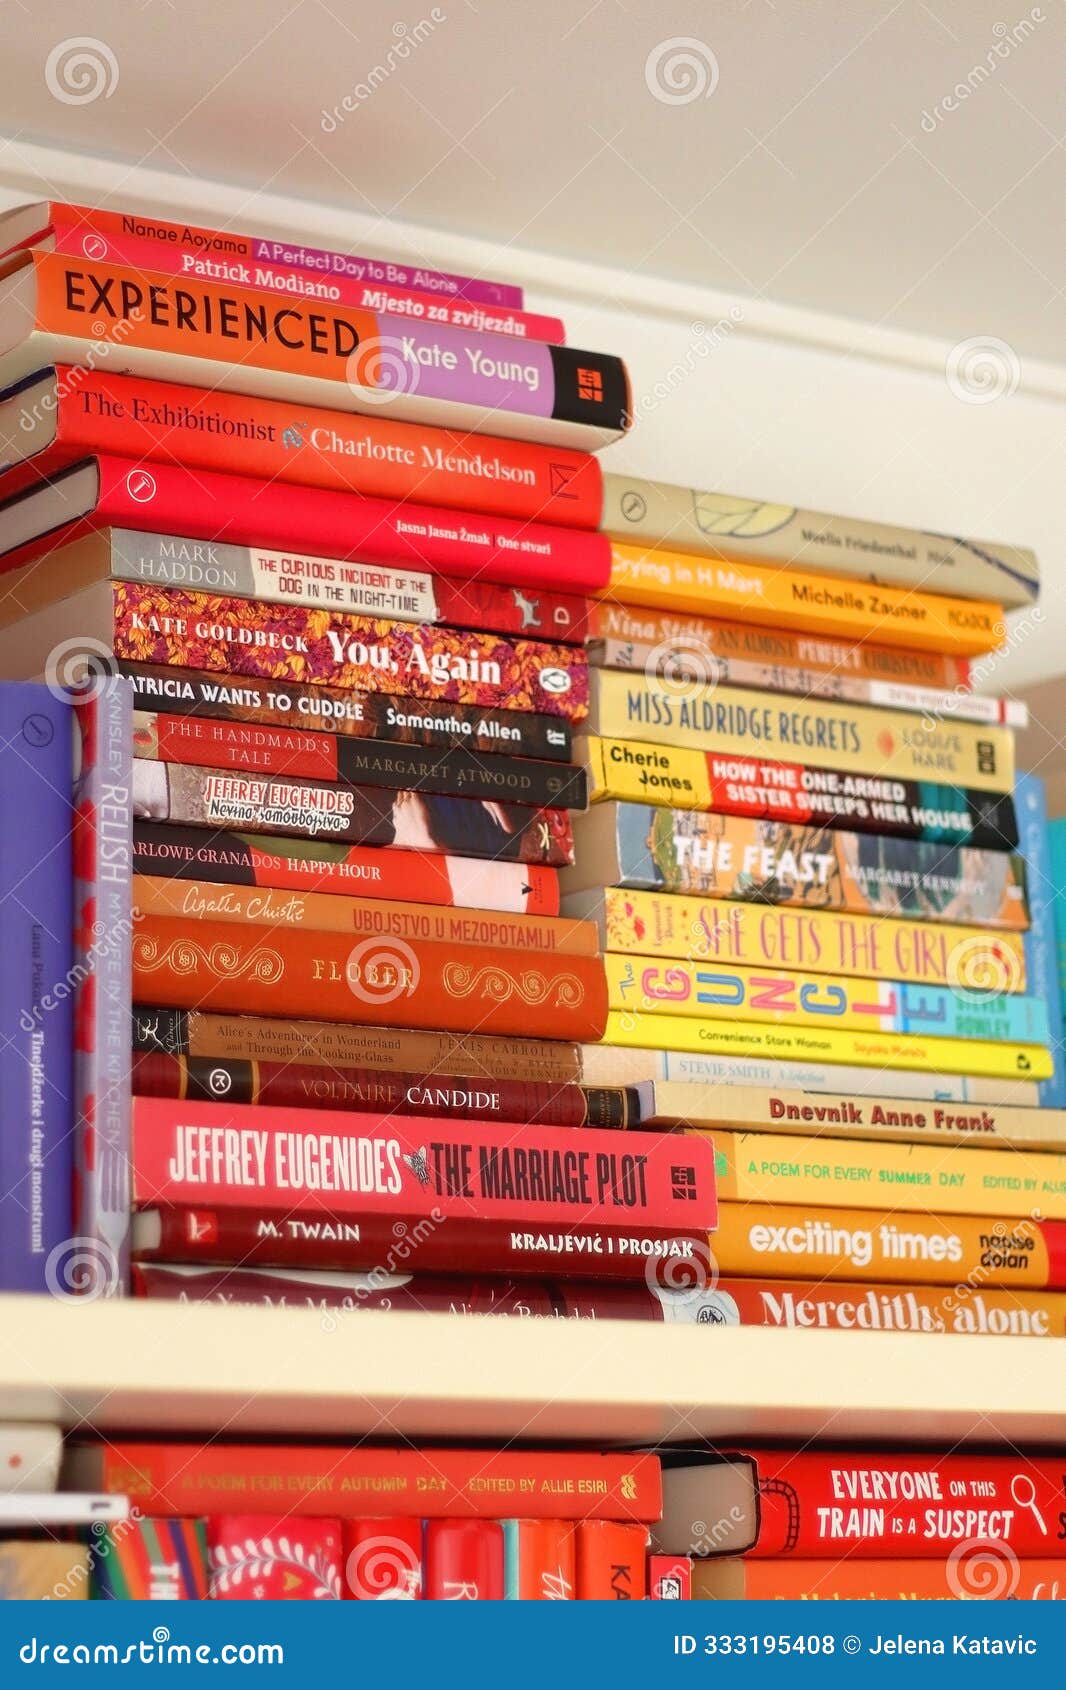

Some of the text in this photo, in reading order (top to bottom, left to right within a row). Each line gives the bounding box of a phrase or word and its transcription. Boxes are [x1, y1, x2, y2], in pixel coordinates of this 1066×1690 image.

[122, 217, 248, 254] Nanae Aoyama
[181, 255, 341, 301] Patrick Modiano
[257, 242, 459, 294] A Perfect Day to Be Alone
[64, 270, 360, 359] EXPERIENCED
[361, 289, 527, 338] Mjesto za zvijezdu
[401, 335, 540, 393] Kate Young
[77, 390, 277, 443] The Exhibitionist
[310, 427, 537, 487] Charlotte Mendelson
[396, 519, 491, 546] Jasna Jasna Žmak
[497, 535, 552, 556] One stvari
[159, 540, 221, 566] MARK
[139, 556, 239, 588] HADDON
[258, 557, 428, 594] THE CURIOUS INCIDENT OF THE
[675, 562, 764, 595] in H Mart
[279, 576, 420, 613] DOG IN THE NIGHT-TIME
[791, 583, 928, 622] Michelle Zauner
[131, 612, 310, 654] KATE GOLDBECK
[326, 630, 502, 686] You, Again
[200, 683, 364, 722] WANTS TO CUDDLE
[108, 692, 123, 777] KNISLEY
[168, 721, 332, 755] THE HANDMAID'S
[386, 707, 522, 742] Samantha Allen
[627, 689, 862, 754] MISS ALDRIDGE REGRETS
[229, 748, 273, 766] TALE
[354, 755, 533, 790] MARGARET ATWOOD
[610, 746, 670, 769] Cherie
[206, 778, 355, 814] JEFFREY EUGENIDES
[638, 770, 693, 791] Jones
[713, 759, 906, 802] HOW THE ONE-ARMED
[726, 784, 975, 833] SISTER SWEEPS HER HOUSE
[100, 783, 129, 884] RELISH
[197, 848, 281, 870] GRANADOS
[287, 857, 382, 881] HAPPY HOUR
[673, 835, 835, 885] THE FEAST
[183, 885, 305, 923] Agatha Christie
[353, 908, 556, 950] UBOJSTVO U MEZOPOTAMIJI
[699, 906, 747, 957] SHE
[760, 912, 822, 965] GETS
[833, 918, 881, 973] THE
[312, 958, 415, 989] FLOBER
[217, 1024, 401, 1051] Alice's Adventures in Wonderland
[247, 1042, 315, 1057] Through the
[698, 1028, 761, 1044] Convenience
[31, 1031, 45, 1119] Tinejdžerke
[107, 1009, 121, 1145] THE KITCHEN
[300, 1079, 501, 1111] VOLTAIRE CANDIDE
[769, 1097, 997, 1134] Dnevnik Anne Frank
[29, 1127, 44, 1168] drugi
[169, 1125, 402, 1195] JEFFREY EUGENIDES
[430, 1142, 649, 1208] THE MARRIAGE PLOT
[748, 1160, 966, 1188] A POEM FOR EVERY SUMMER DAY
[32, 1169, 44, 1253] monstrumi
[257, 1220, 361, 1243] M. TWAIN
[510, 1231, 694, 1259] KRALJEVIĆ I PROSJAK
[749, 1220, 963, 1266] exciting times
[953, 1296, 1049, 1336] alone
[416, 1476, 448, 1490] DAY
[469, 1478, 608, 1494] EDITED BY ALLIE ESIRI
[830, 1469, 997, 1500] EVERYONE ON THIS
[817, 1507, 1015, 1540] TRAIN IS A SUSPECT
